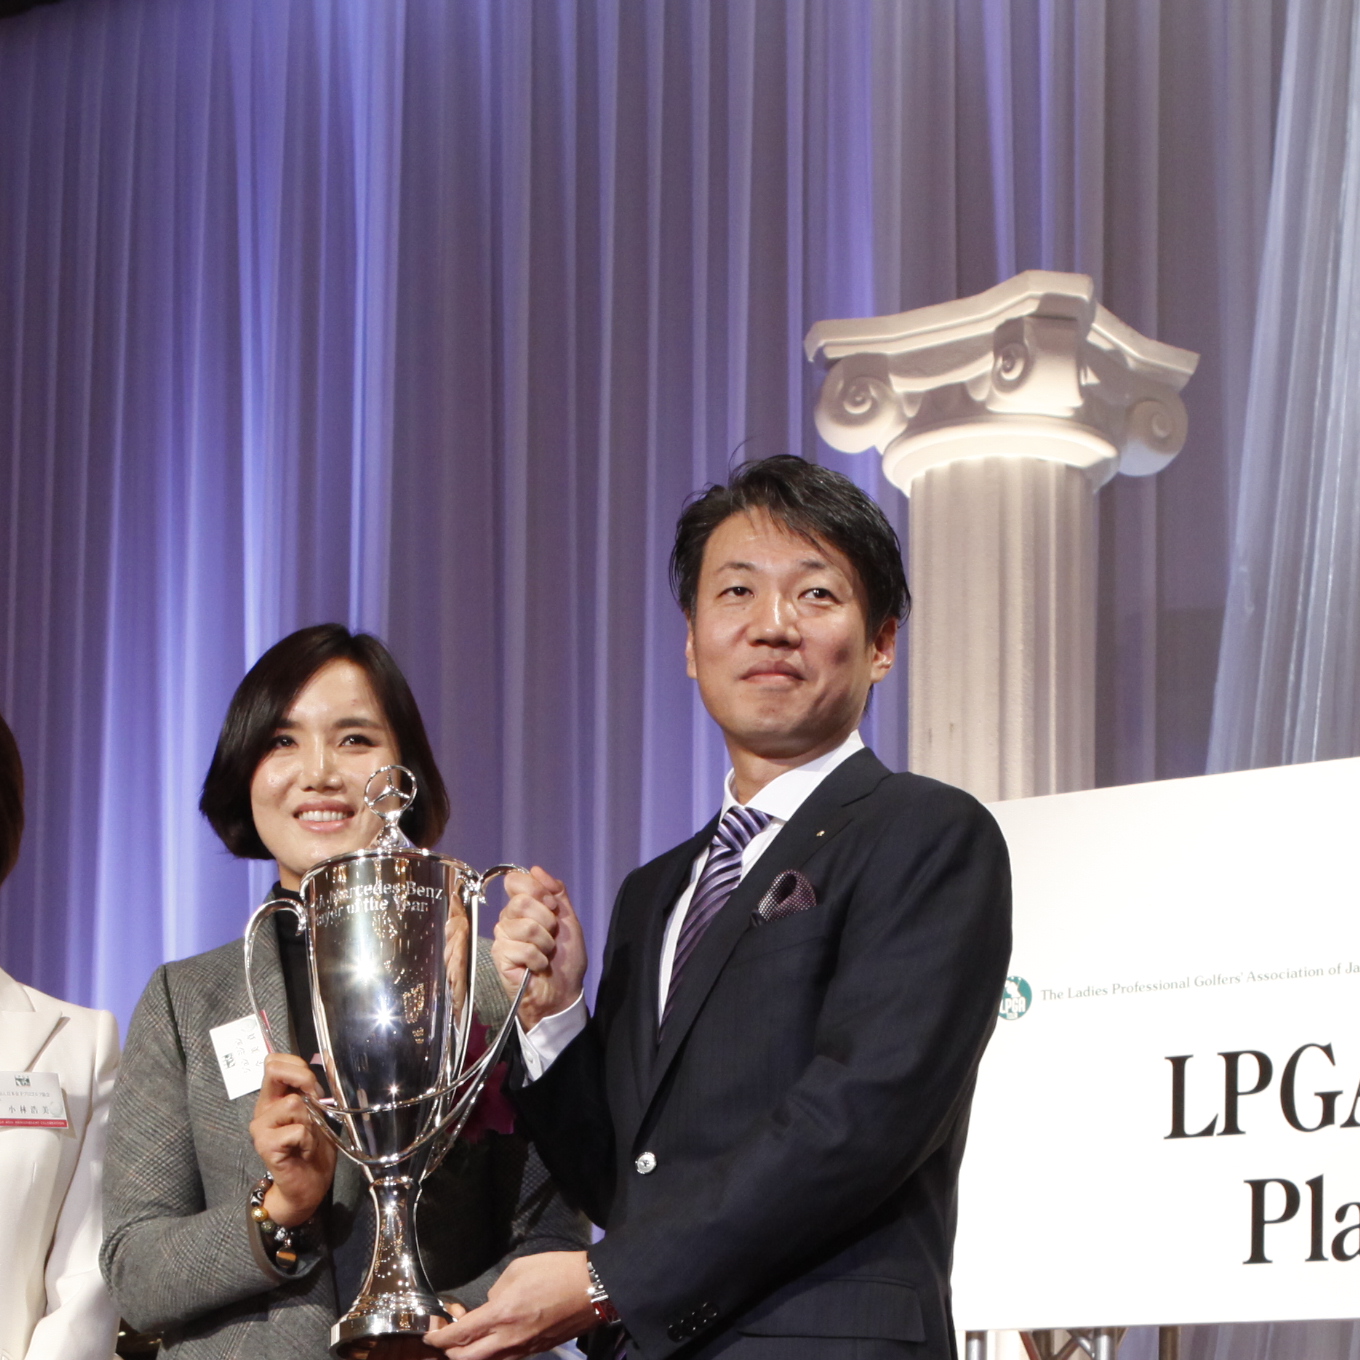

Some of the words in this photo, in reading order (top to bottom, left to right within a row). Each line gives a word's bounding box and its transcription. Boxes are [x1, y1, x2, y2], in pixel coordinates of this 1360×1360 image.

[364, 895, 388, 912] the
[1041, 986, 1064, 1001] The
[1067, 983, 1109, 998] Ladies
[1111, 976, 1190, 995] Professional
[1246, 967, 1324, 983] Association
[1327, 961, 1342, 976] of
[999, 996, 1027, 1014] LPGA
